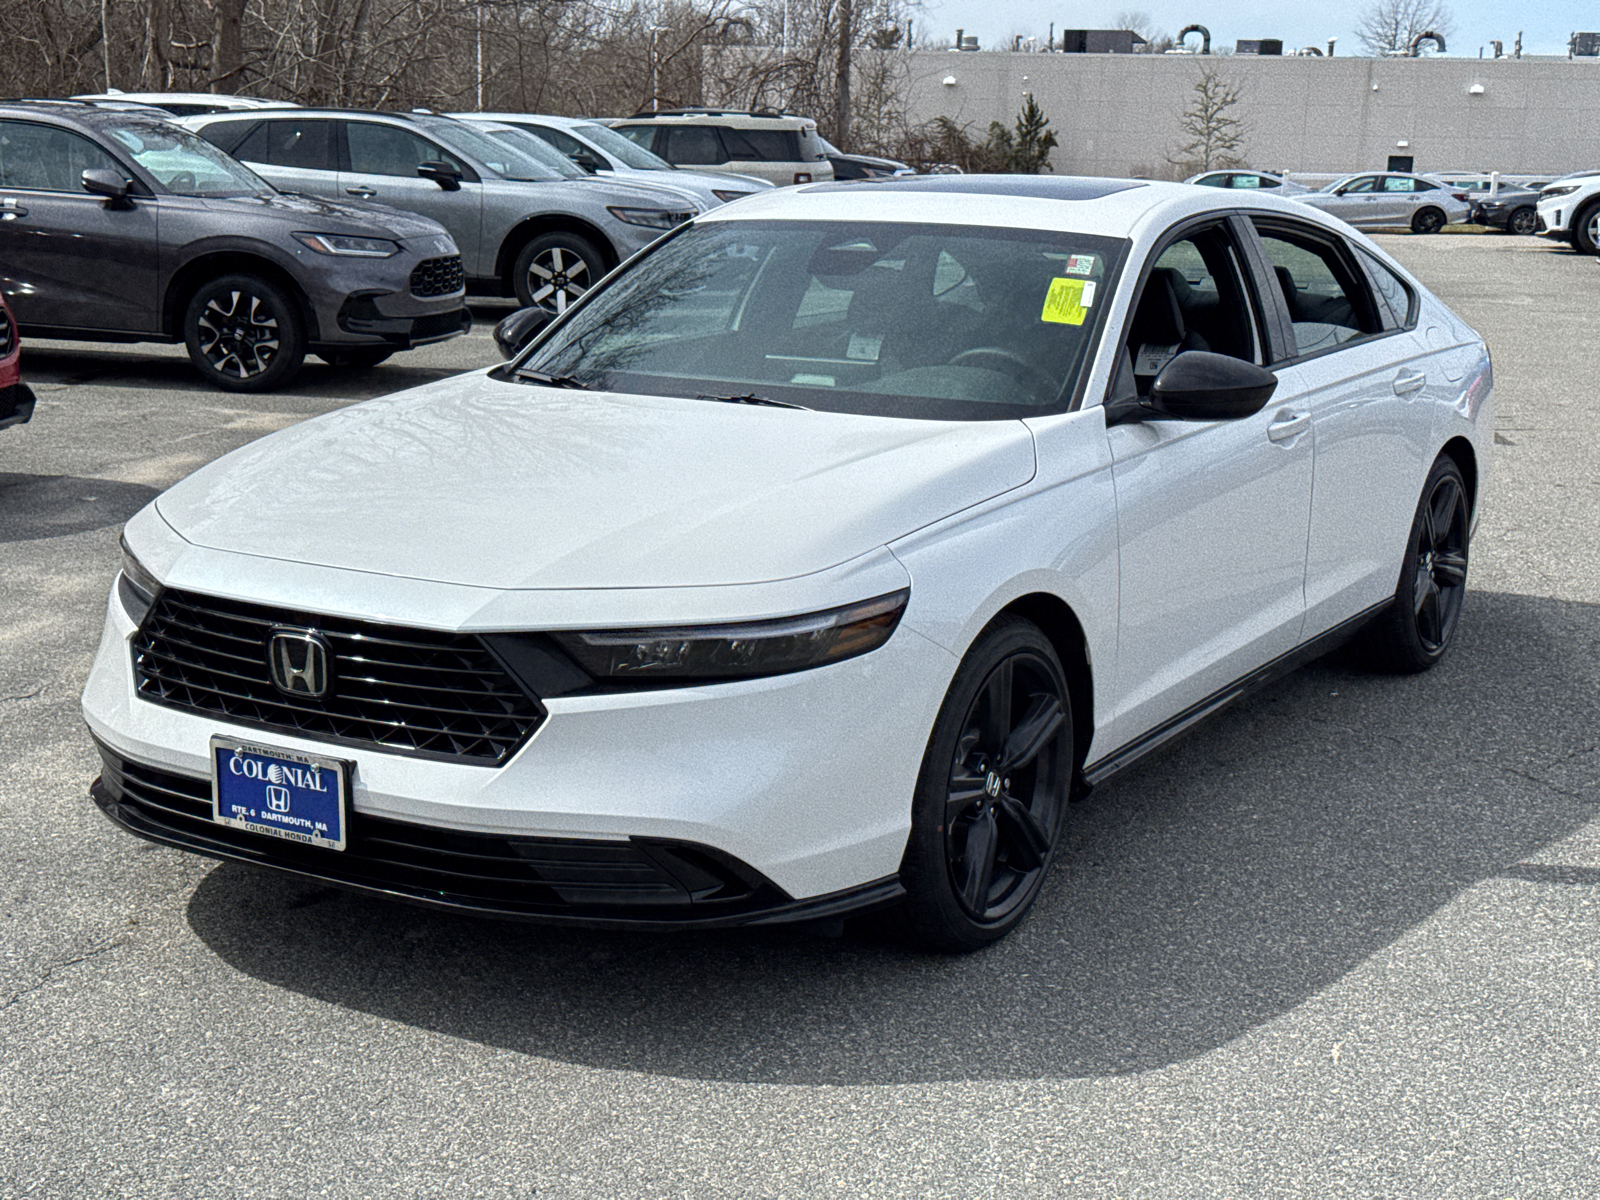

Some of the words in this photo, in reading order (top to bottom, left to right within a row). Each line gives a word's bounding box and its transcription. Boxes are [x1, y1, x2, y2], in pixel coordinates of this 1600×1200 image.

[296, 755, 310, 764] MA
[229, 756, 327, 793] COLONIAL
[250, 808, 256, 817] 6
[261, 810, 314, 829] DARTMOUTH,
[315, 821, 328, 832] MA
[245, 822, 283, 838] COLONIAL
[284, 831, 313, 844] HONDA
